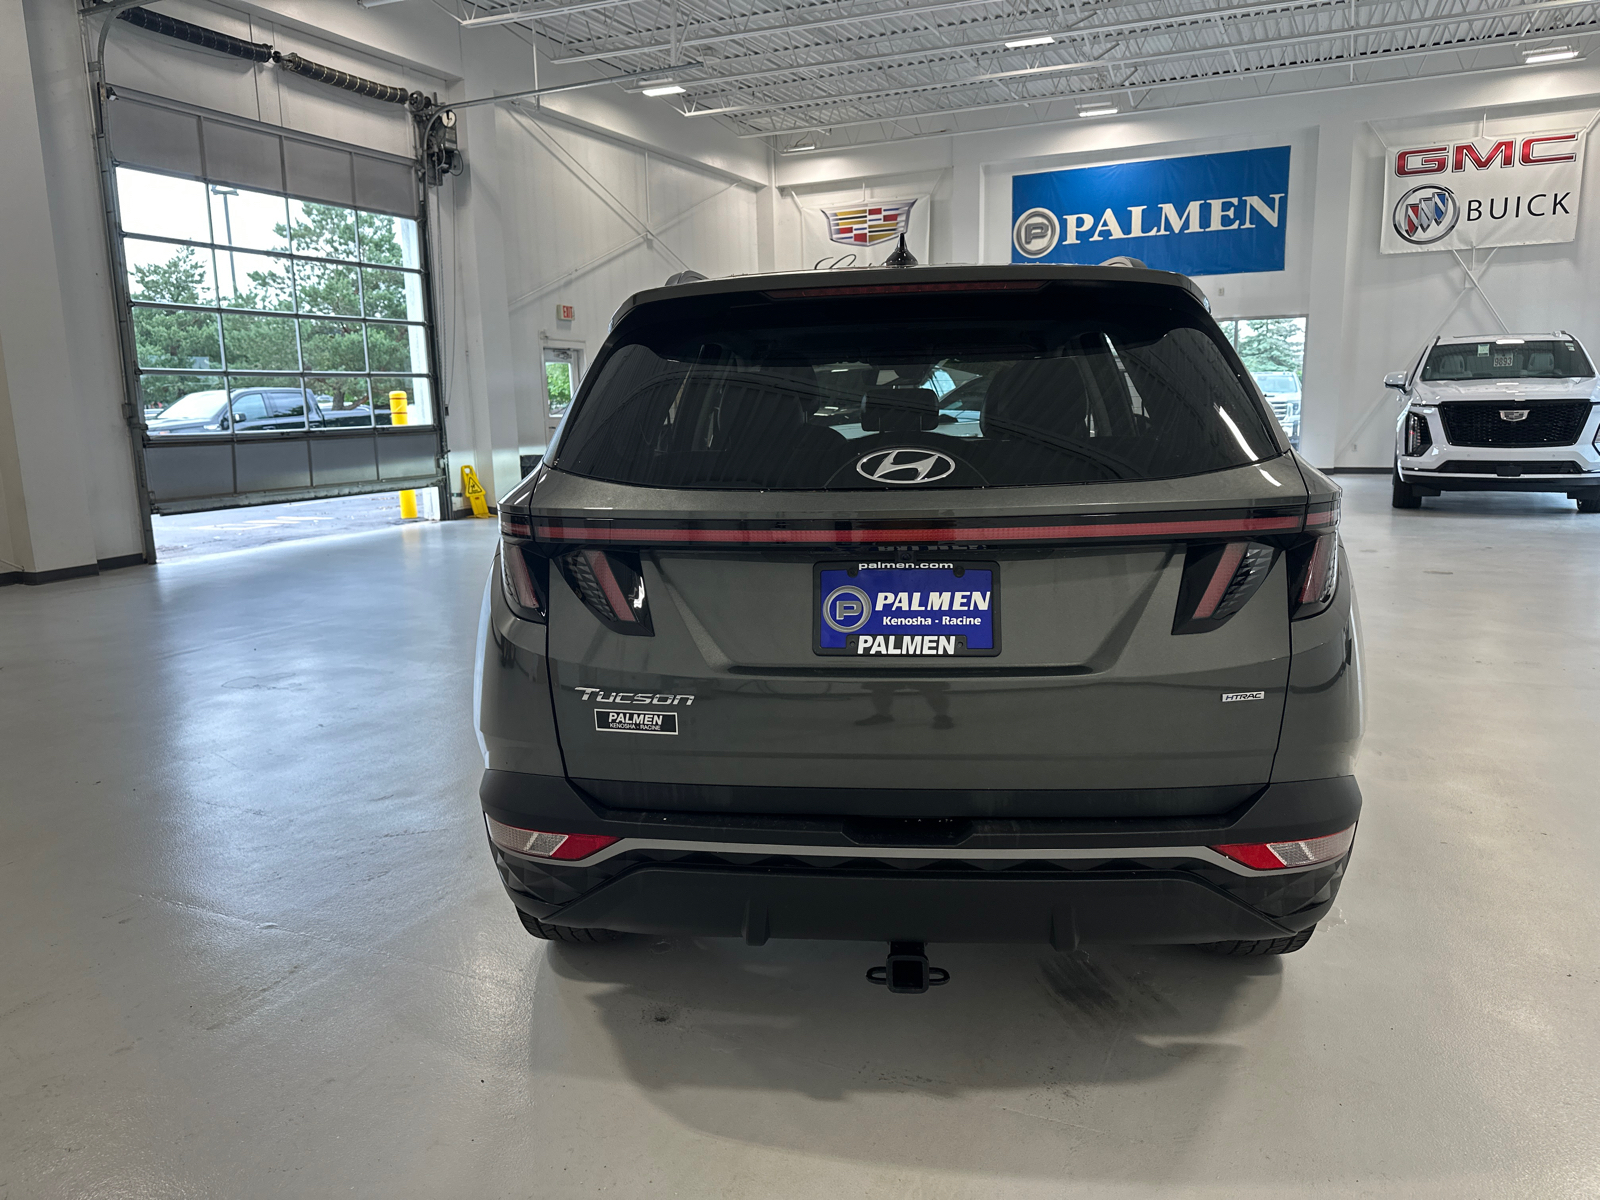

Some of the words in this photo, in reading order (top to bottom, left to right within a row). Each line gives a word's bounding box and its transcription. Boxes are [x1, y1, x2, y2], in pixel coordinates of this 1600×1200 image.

[1394, 132, 1579, 178] GMC
[1466, 191, 1571, 222] BUICK
[1062, 193, 1285, 245] PALMEN
[858, 561, 954, 571] palmen.com
[874, 591, 991, 611] PALMEN
[882, 616, 932, 626] Kenosha
[941, 616, 982, 626] Racine
[857, 635, 956, 655] PALMEN
[1225, 692, 1262, 701] HTRAC
[608, 712, 663, 726] PALMEN
[609, 722, 636, 730] KENOSHA
[640, 723, 661, 731] RACINE
